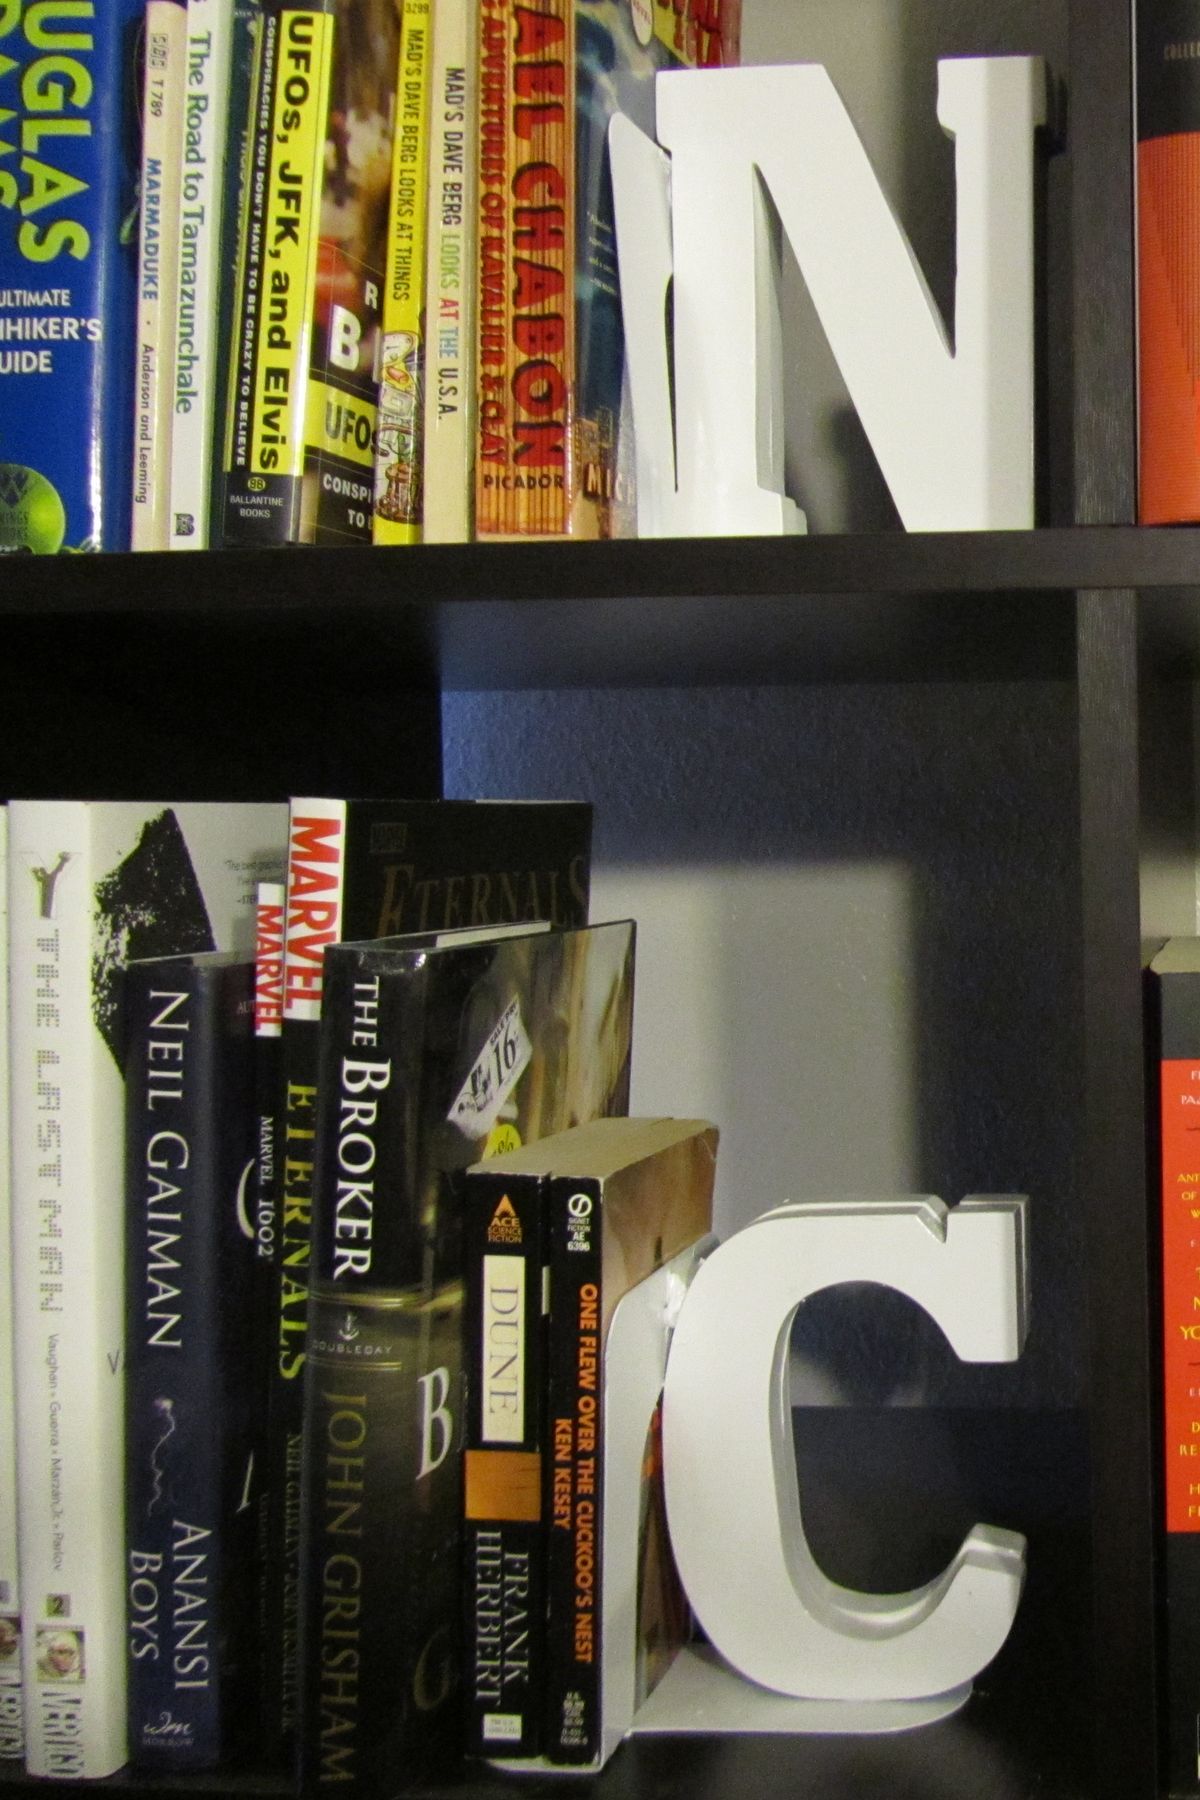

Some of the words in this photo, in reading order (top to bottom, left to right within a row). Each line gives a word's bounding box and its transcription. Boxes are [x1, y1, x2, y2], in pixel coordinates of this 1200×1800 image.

[188, 30, 212, 87] The
[258, 16, 276, 131] CONSPIRACIES
[274, 15, 314, 144] UFOs,
[404, 28, 424, 78] MAD'S
[402, 81, 422, 120] DAVE
[443, 66, 465, 124] MAD'S
[184, 93, 209, 165] Road
[399, 124, 419, 164] BERG
[443, 131, 464, 174] DAVE
[182, 171, 205, 202] to
[267, 160, 303, 260] JFK,
[396, 166, 416, 218] LOOKS
[440, 181, 463, 227] BERG
[142, 157, 162, 300] MARMADUKE
[250, 221, 264, 261] HAVE
[392, 248, 412, 302] THINGS
[439, 232, 462, 290] LOOKS
[175, 205, 205, 415] Tamazunchale
[267, 269, 292, 351] and
[438, 297, 460, 321] AT
[510, 161, 568, 467] CHABON
[242, 320, 256, 371] CRAZY
[437, 328, 459, 359] THE
[140, 343, 155, 410] Anderson
[138, 415, 152, 441] and
[235, 401, 250, 467] BELIEVE
[259, 366, 291, 471] Elvis
[134, 446, 151, 505] Leeming
[230, 495, 285, 507] BALLANTINE
[483, 472, 564, 490] PICADOR
[239, 508, 272, 520] BOOKS
[283, 816, 342, 1011] MARVEL
[254, 904, 283, 1031] MARVEL
[351, 975, 381, 1048] THE
[148, 987, 191, 1112] NEIL
[258, 1116, 275, 1185] MARVEL
[333, 1056, 391, 1280] BROKER
[146, 1130, 190, 1350] GAIMAN
[279, 1081, 318, 1380] ETERNALS
[578, 1282, 599, 1331] ONE
[489, 1286, 520, 1415] DUNE
[577, 1335, 598, 1391] FLEW
[554, 1418, 573, 1461] KEN
[576, 1395, 597, 1452] OVER
[321, 1390, 367, 1536] JOHN
[576, 1457, 595, 1496] THE
[553, 1467, 572, 1530] KESEY
[574, 1500, 595, 1608] CUCKOO'S
[130, 1548, 164, 1662] BOYS
[172, 1519, 213, 1691] ANANSI
[475, 1530, 503, 1706] HERBERT
[503, 1551, 530, 1684] FRANK
[317, 1553, 362, 1782] GRISHAM
[574, 1612, 594, 1664] NEST
